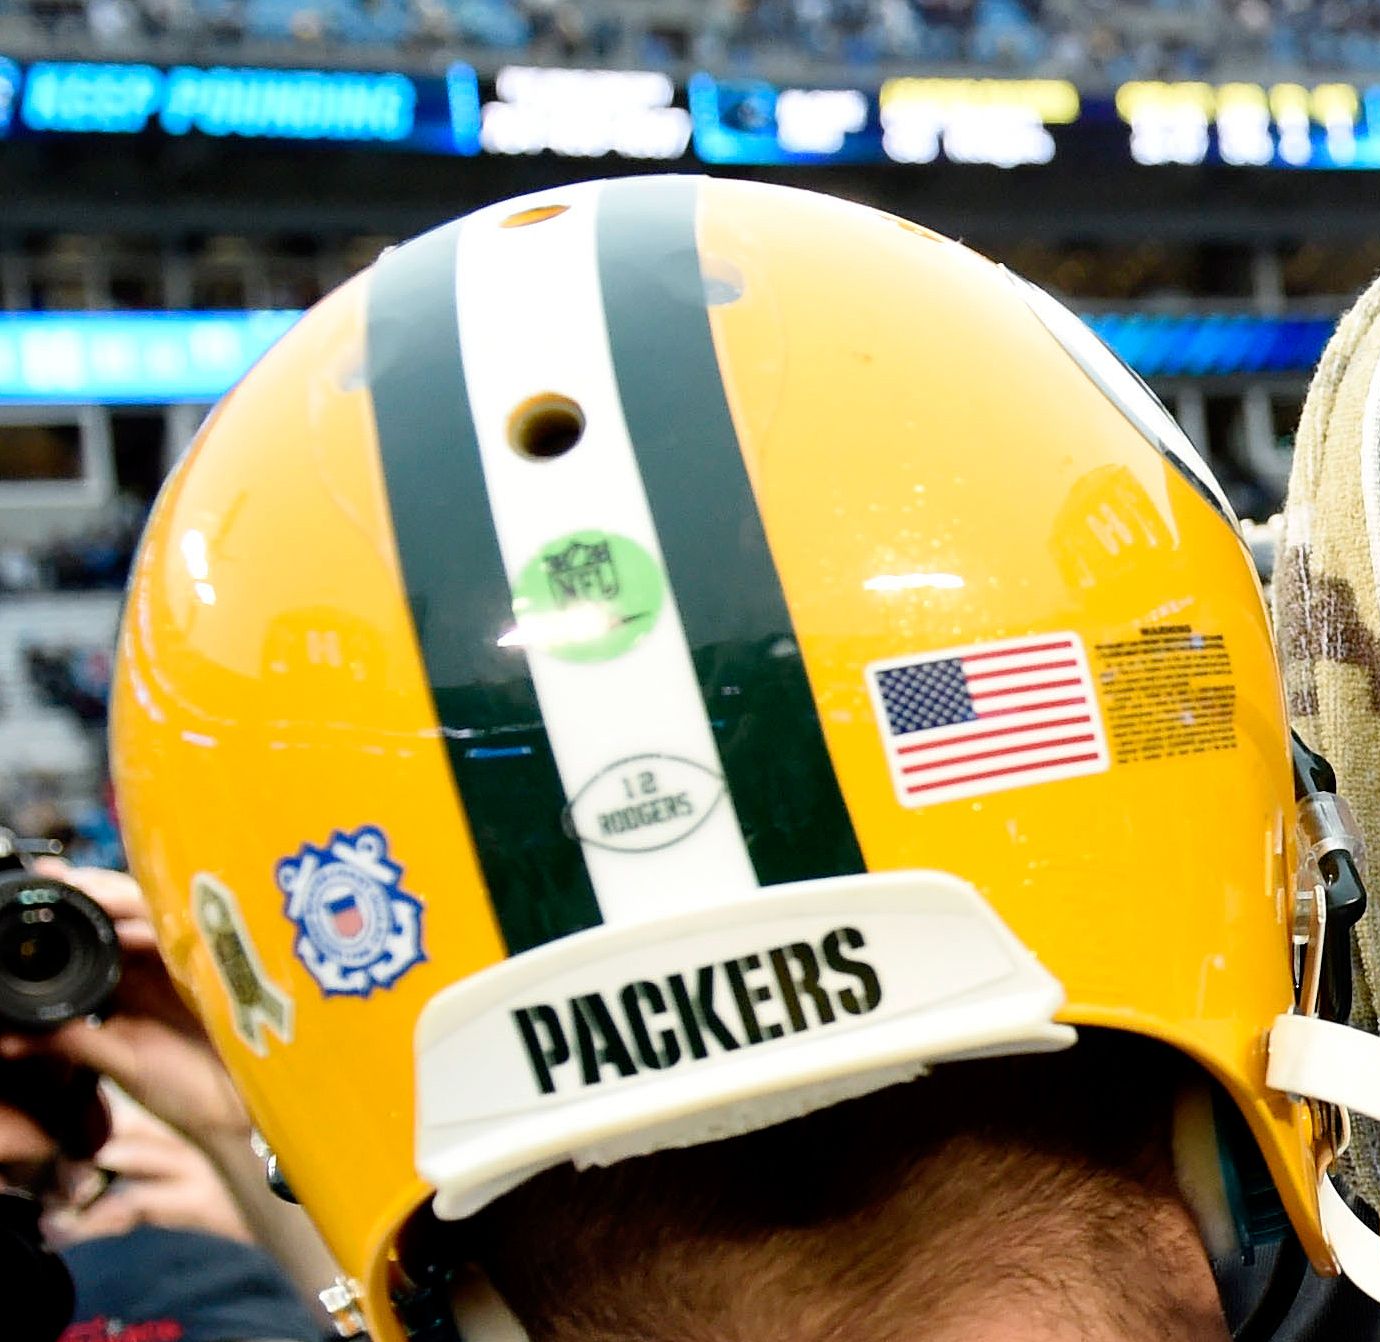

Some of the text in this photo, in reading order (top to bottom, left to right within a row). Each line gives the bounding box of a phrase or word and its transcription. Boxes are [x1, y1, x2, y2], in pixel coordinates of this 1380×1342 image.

[622, 771, 657, 798] 12
[598, 791, 693, 836] RODGERS
[511, 927, 882, 1094] PACKERS
